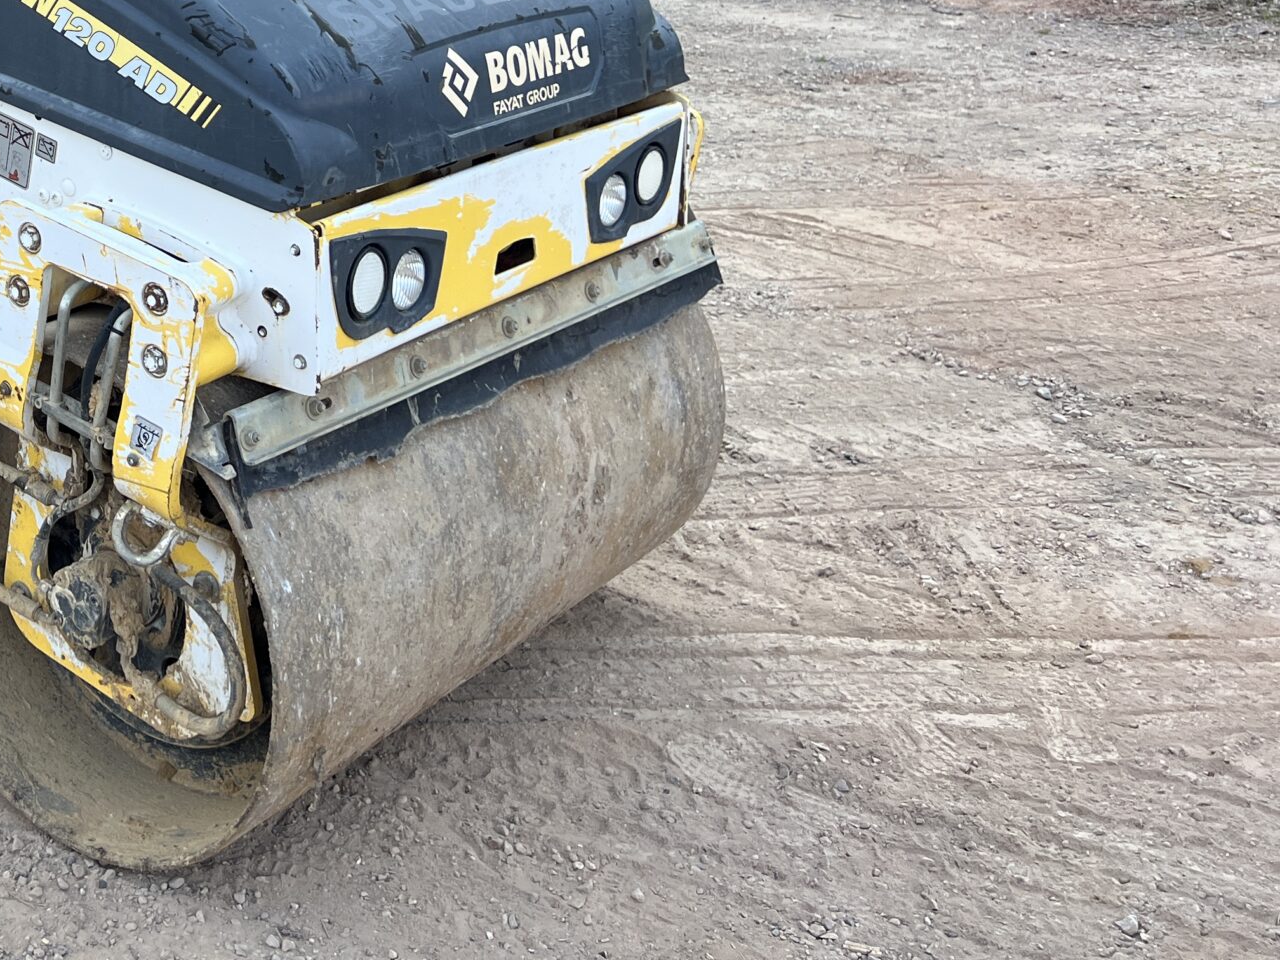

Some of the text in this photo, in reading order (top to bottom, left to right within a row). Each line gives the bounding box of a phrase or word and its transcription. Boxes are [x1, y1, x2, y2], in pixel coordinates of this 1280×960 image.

[484, 26, 591, 94] BOMAG
[493, 82, 561, 116] FAYAT GROUP
